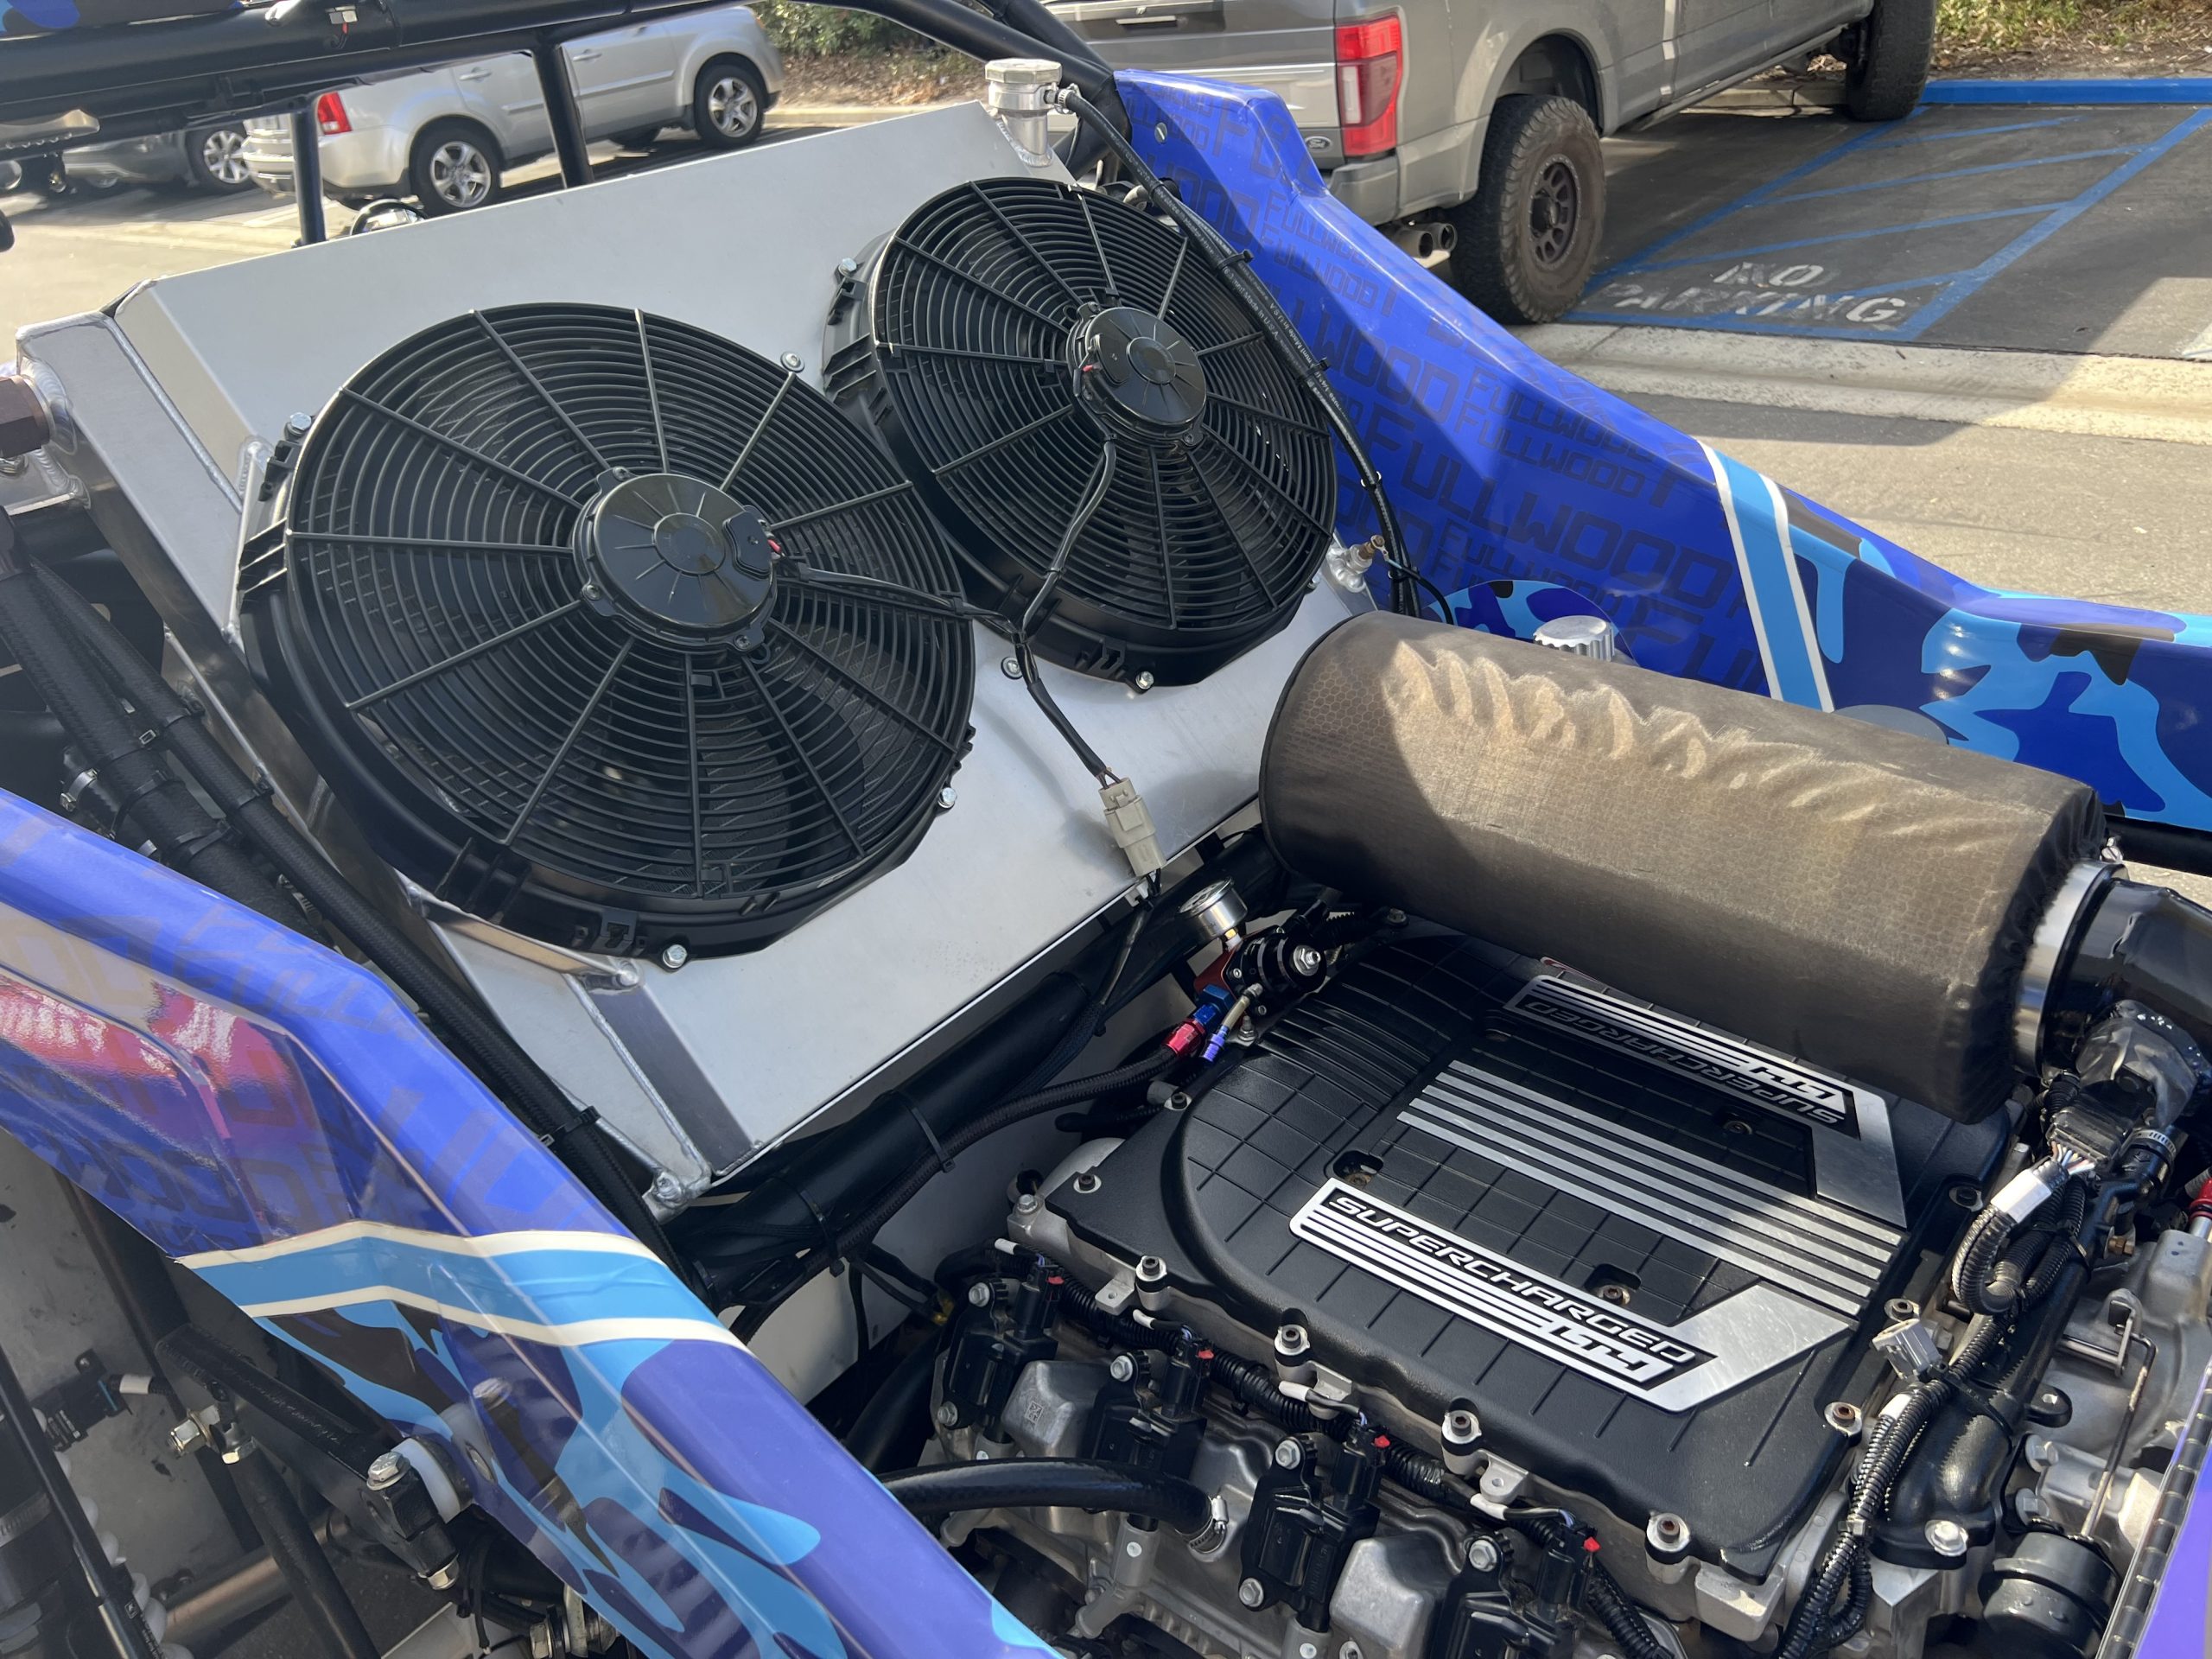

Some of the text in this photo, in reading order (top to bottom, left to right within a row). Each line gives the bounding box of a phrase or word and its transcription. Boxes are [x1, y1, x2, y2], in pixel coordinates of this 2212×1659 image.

[1241, 290, 1261, 311] Made
[1605, 283, 1906, 324] PARKING
[1713, 261, 1825, 288] NO
[1286, 327, 1303, 349] Made
[1454, 401, 1646, 499] FULLWOOD
[1364, 402, 1733, 610] FULLWOOD
[1525, 1001, 1845, 1124] SUPERCHARGED
[1328, 1195, 1696, 1363] SUPERCHARGED
